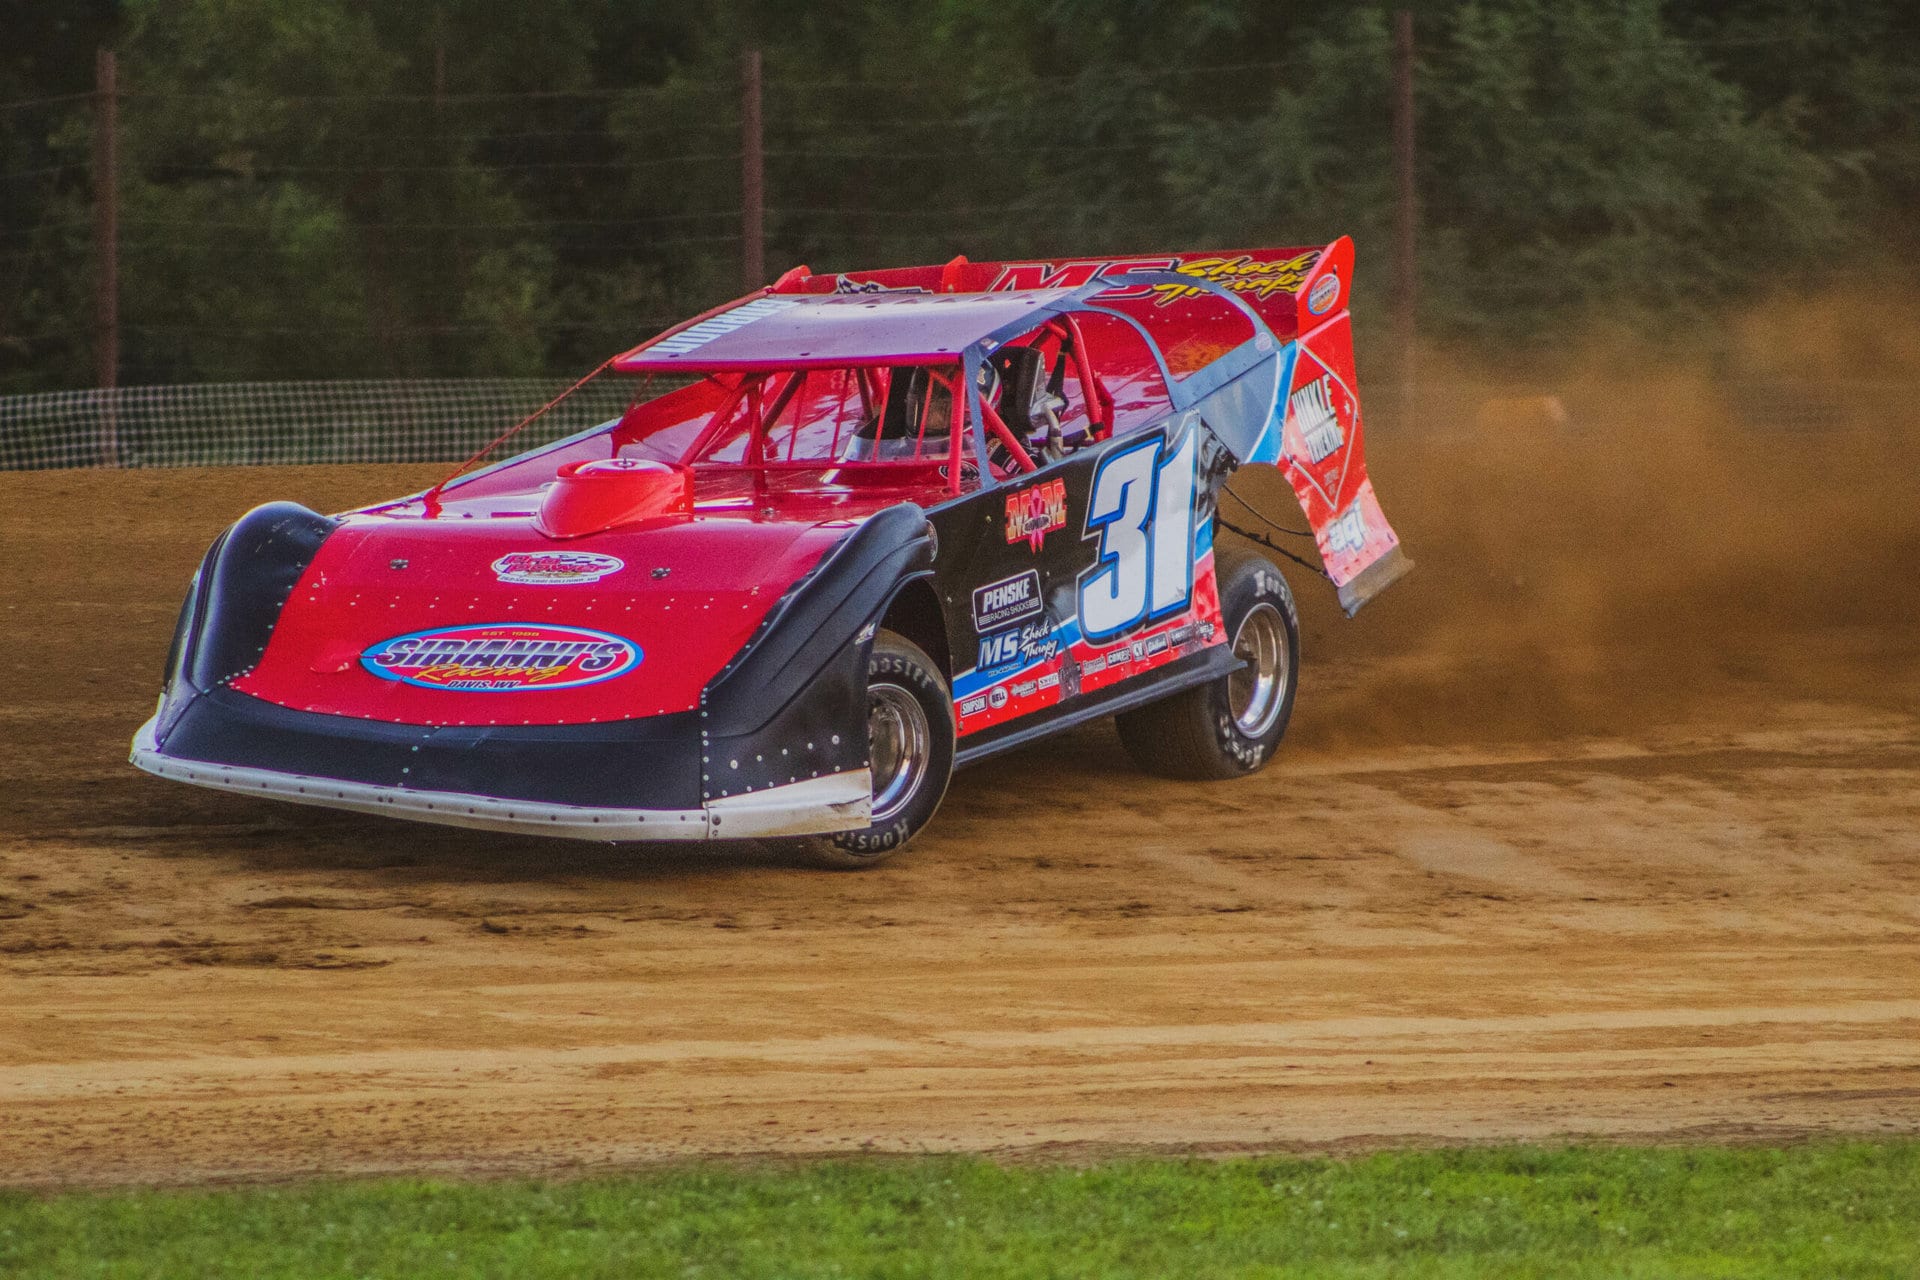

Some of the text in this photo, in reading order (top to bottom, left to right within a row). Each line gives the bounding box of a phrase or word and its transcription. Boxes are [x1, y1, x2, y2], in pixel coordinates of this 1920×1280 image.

[1176, 251, 1321, 277] Shock
[1080, 420, 1196, 641] 31
[983, 577, 1030, 614] PENSKE
[990, 601, 1030, 622] RACING SHOCKS
[1019, 620, 1050, 648] Shock
[374, 638, 626, 671] SIRIANNI'S
[979, 630, 1020, 669] MS
[1021, 640, 1058, 664] Therapy
[412, 662, 569, 683] Racing
[493, 680, 521, 688] WV
[992, 691, 1006, 703] BELL
